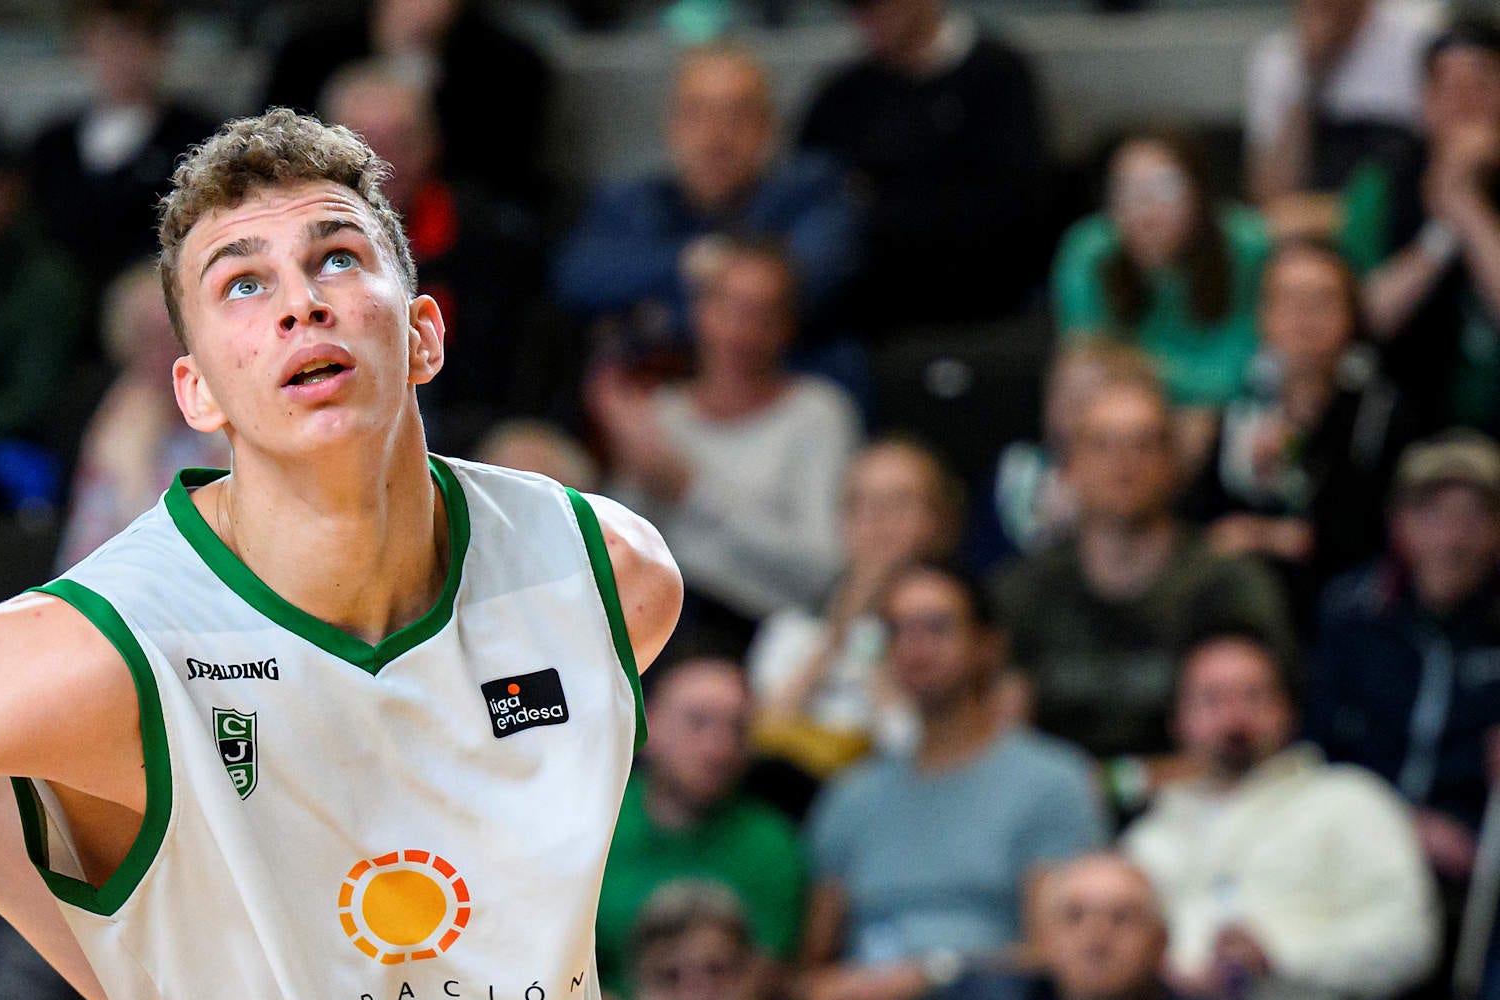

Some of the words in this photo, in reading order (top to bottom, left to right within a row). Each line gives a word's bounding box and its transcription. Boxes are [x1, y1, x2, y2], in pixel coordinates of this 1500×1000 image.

[186, 657, 279, 680] SPALDING
[489, 695, 520, 715] liga
[496, 704, 563, 730] endesa
